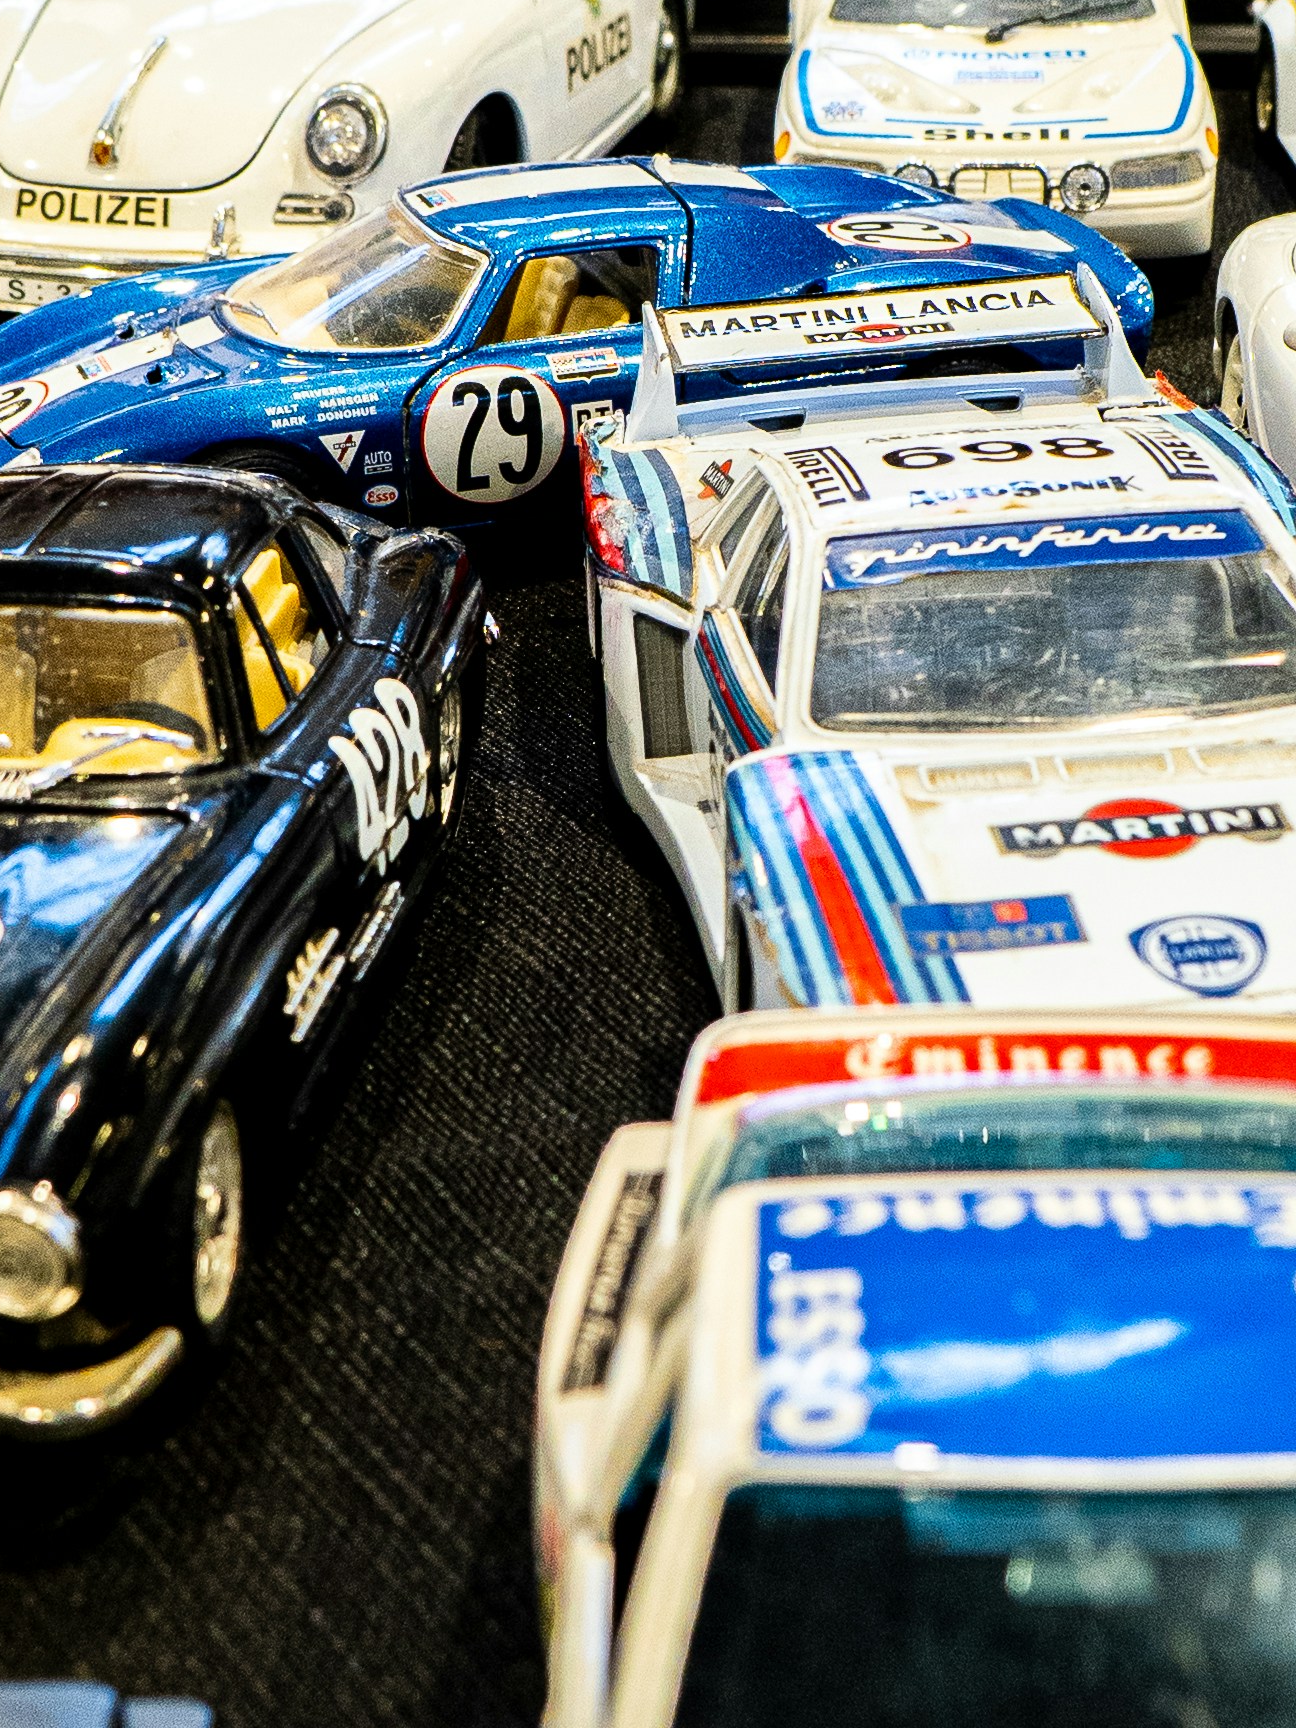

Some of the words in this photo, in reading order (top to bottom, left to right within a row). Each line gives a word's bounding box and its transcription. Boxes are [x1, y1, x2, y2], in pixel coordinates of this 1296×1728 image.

[567, 14, 633, 92] POLIZEI
[936, 48, 1087, 60] PIONEER
[923, 127, 1072, 141] Shell
[16, 188, 171, 228] POLIZEI
[838, 221, 960, 243] 29
[680, 304, 871, 340] MARTINI
[886, 288, 1057, 320] LANCIA
[813, 322, 950, 344] MARTINI
[265, 403, 300, 417] WALT
[319, 392, 380, 410] HANSGEN
[293, 386, 346, 400] DRIVERS
[270, 415, 308, 429] MARK
[317, 406, 378, 423] DONOHUE
[452, 375, 544, 494] 29
[364, 450, 392, 466] AUTO
[881, 436, 1115, 470] 698
[702, 464, 731, 496] MARTINI
[366, 490, 397, 505] Esso
[844, 522, 1227, 578] pininfarina
[327, 678, 431, 869] 428
[1012, 805, 1281, 854] MARTINI
[919, 920, 1070, 950] TISSOT
[844, 1035, 1216, 1079] Eminence
[760, 1269, 871, 1450] ESSO
